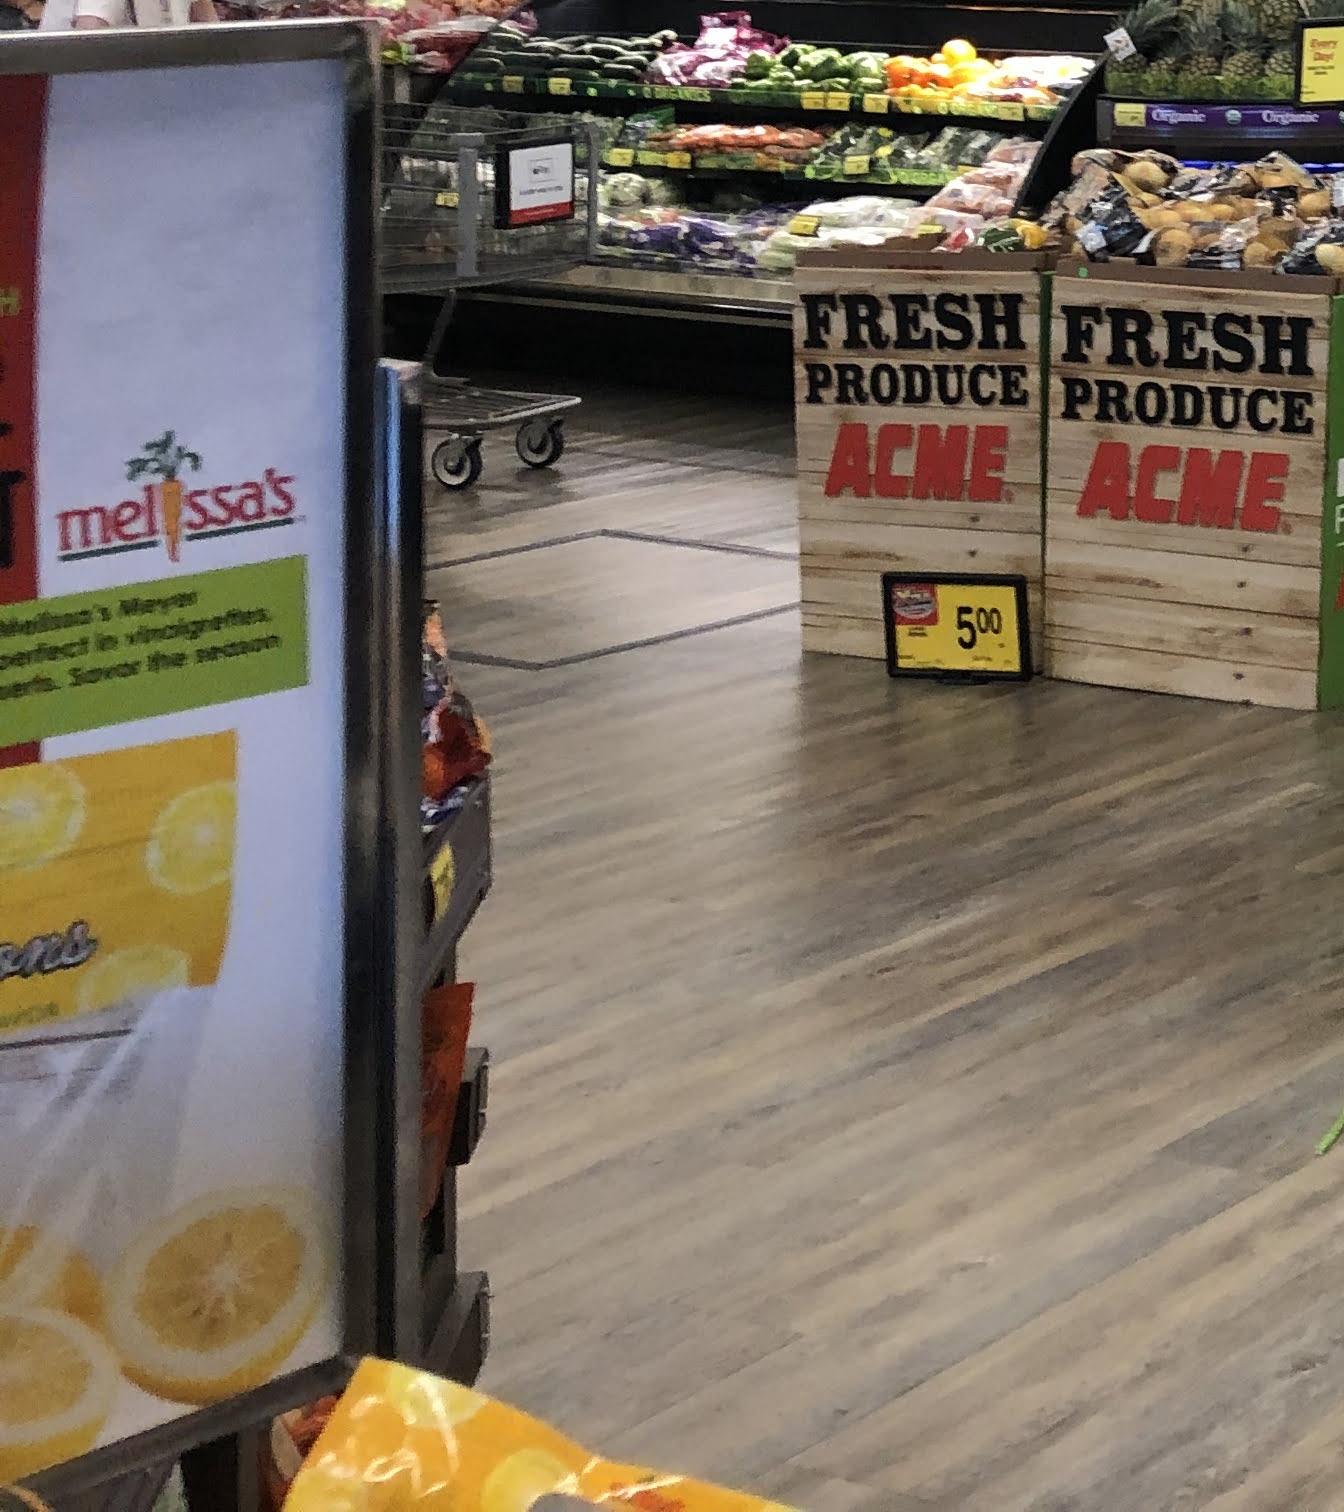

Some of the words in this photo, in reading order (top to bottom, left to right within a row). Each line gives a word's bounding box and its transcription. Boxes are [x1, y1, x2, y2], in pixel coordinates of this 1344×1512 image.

[1152, 108, 1206, 124] Organic
[1262, 110, 1319, 125] Organic
[801, 292, 1027, 351] FRESH
[1060, 304, 1314, 376] FRESH
[804, 363, 1029, 406] PRODUCE
[1062, 376, 1314, 434] PRODUCE
[824, 423, 1009, 502] ACME
[1076, 440, 1290, 532] ACME
